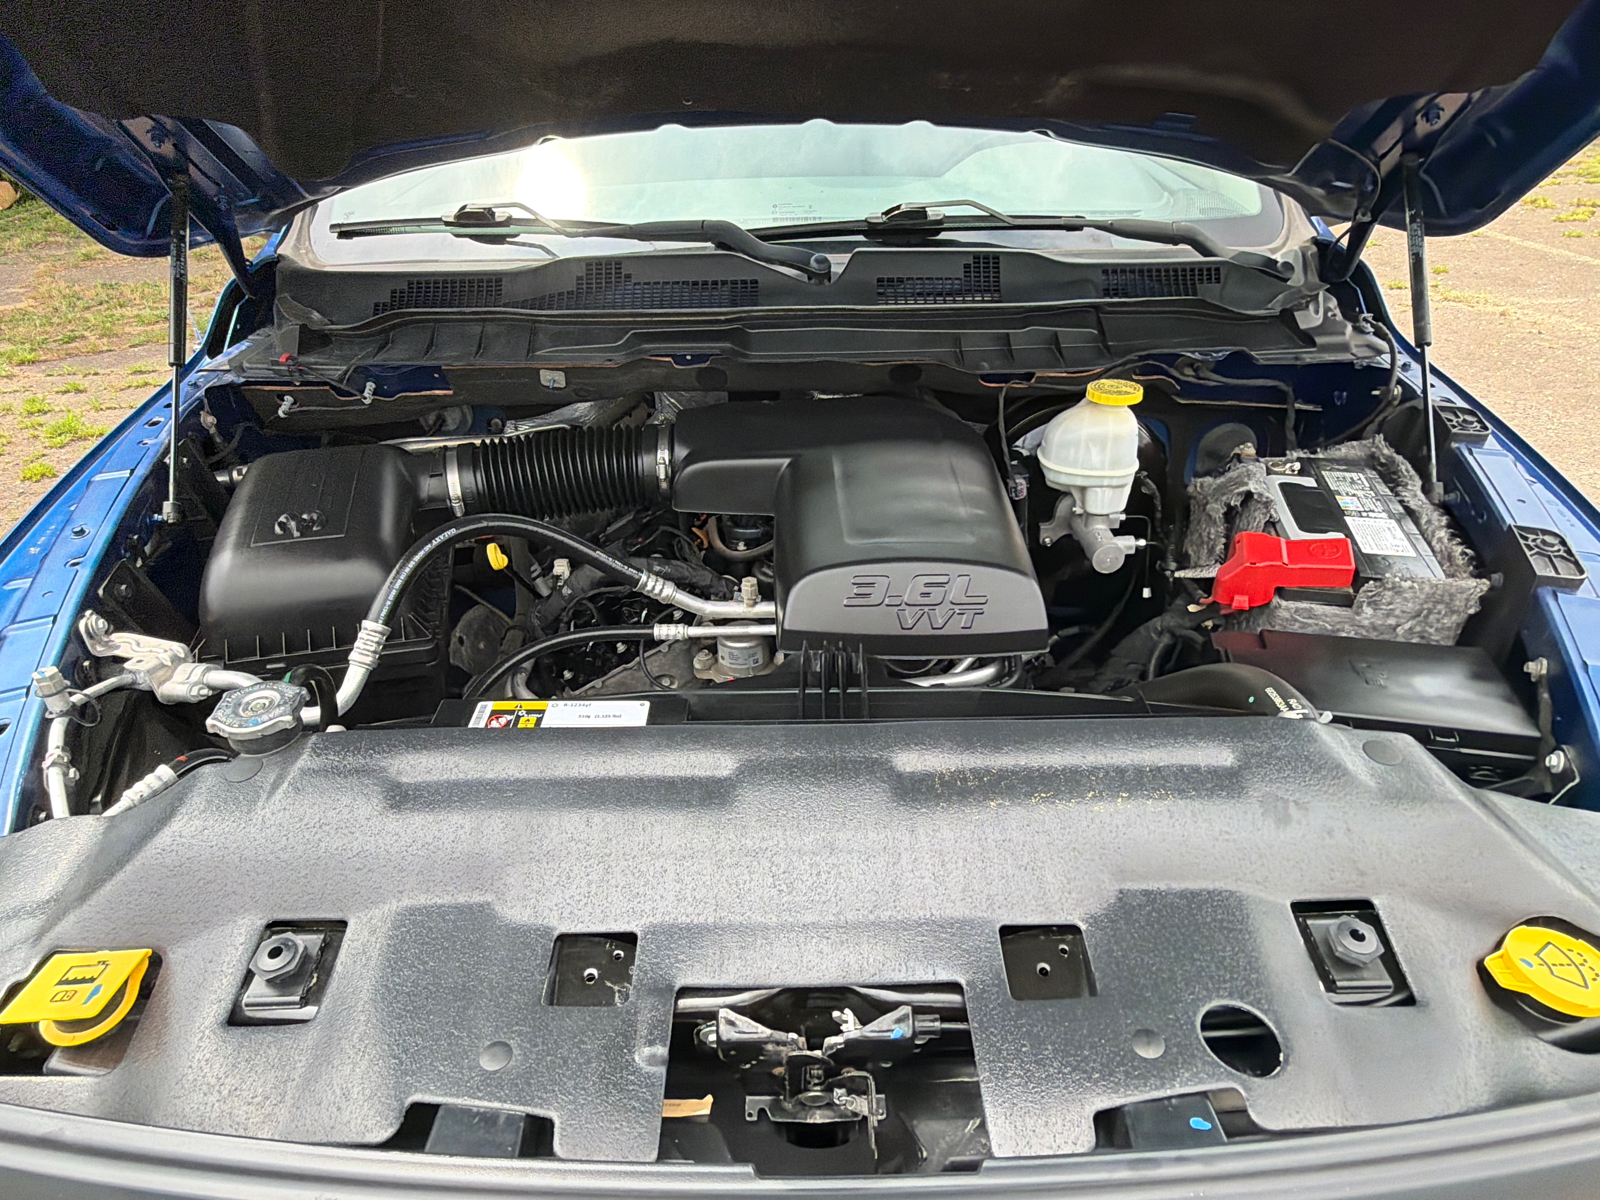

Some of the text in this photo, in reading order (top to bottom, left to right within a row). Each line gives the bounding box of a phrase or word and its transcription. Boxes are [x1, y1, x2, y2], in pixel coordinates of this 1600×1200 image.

[431, 527, 457, 546] GALAXY
[843, 573, 989, 607] 3.6L
[896, 607, 985, 630] VVT
